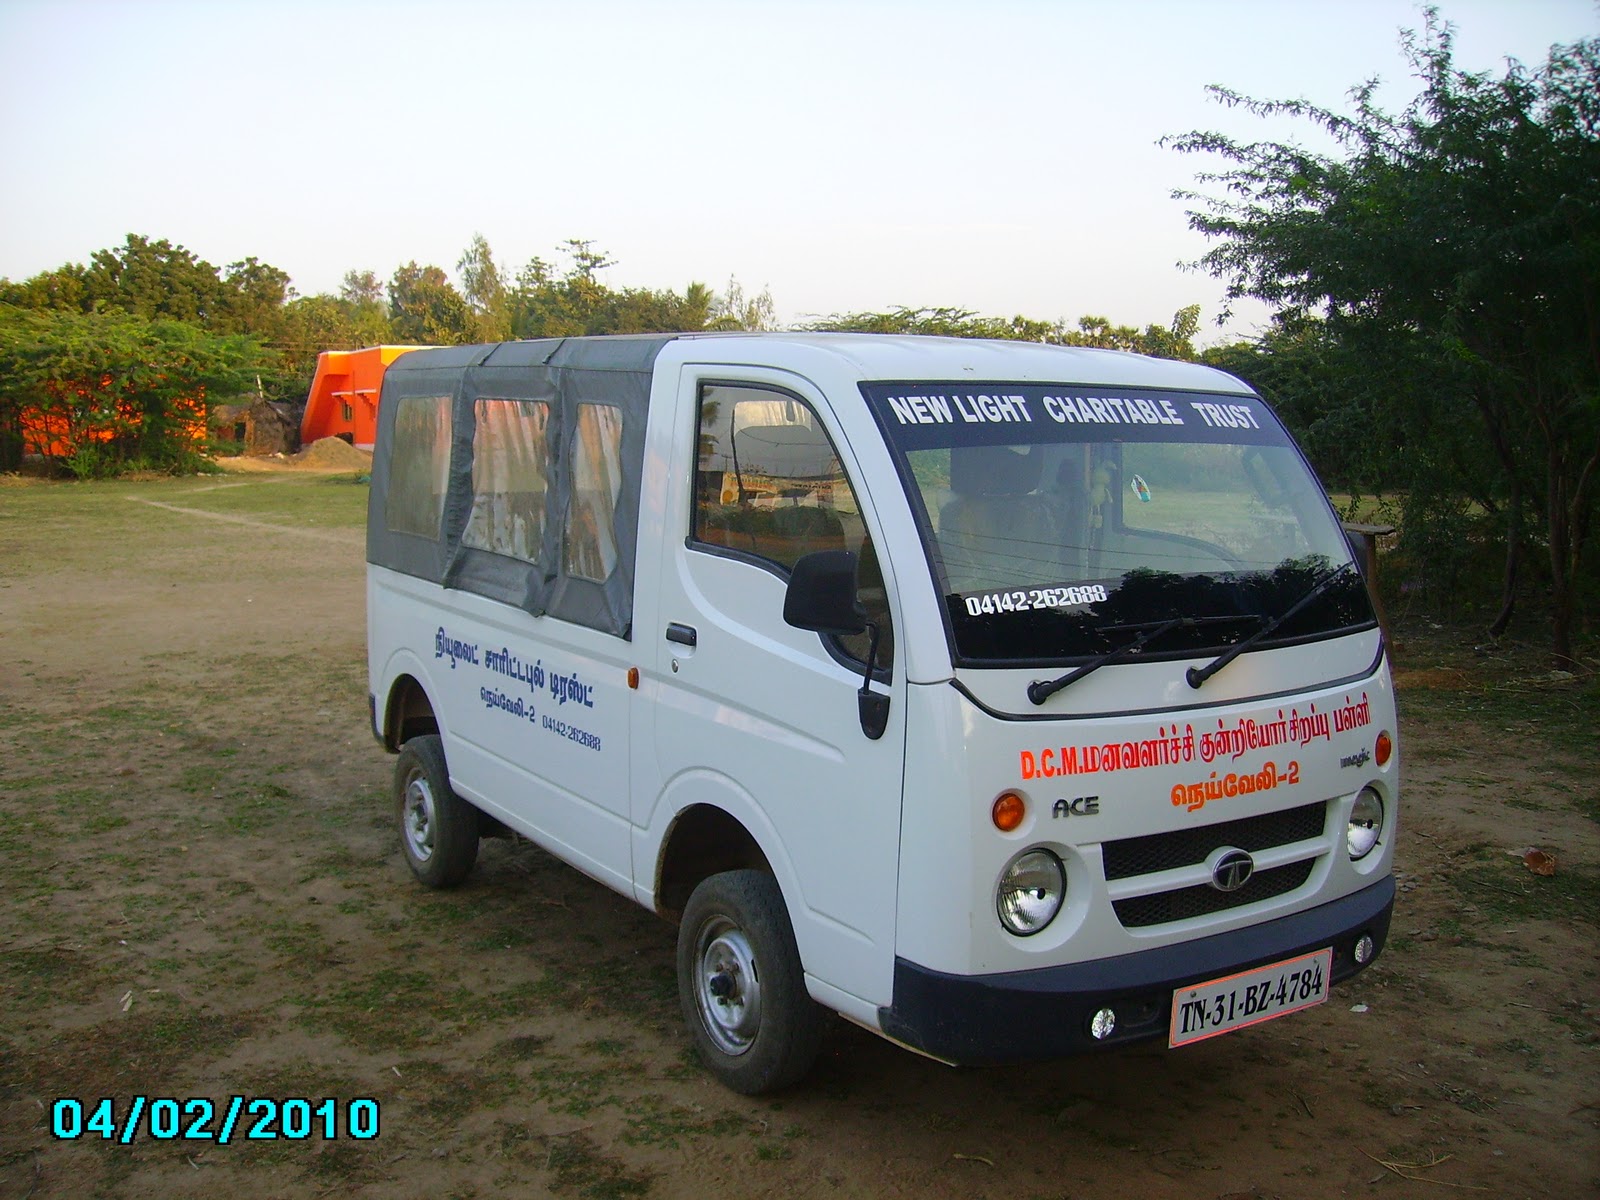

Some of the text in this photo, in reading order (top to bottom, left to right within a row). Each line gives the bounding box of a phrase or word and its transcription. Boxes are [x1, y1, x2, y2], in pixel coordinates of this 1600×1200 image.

[887, 395, 1260, 430] NEW LIGHT CHARITABLE TRUST
[965, 584, 1108, 616] 04142-262688
[549, 672, 594, 708] டிரஸ்ட்
[1333, 692, 1372, 733] பள்ளி
[542, 714, 601, 751] 04142-262688
[1052, 796, 1100, 819] ACE
